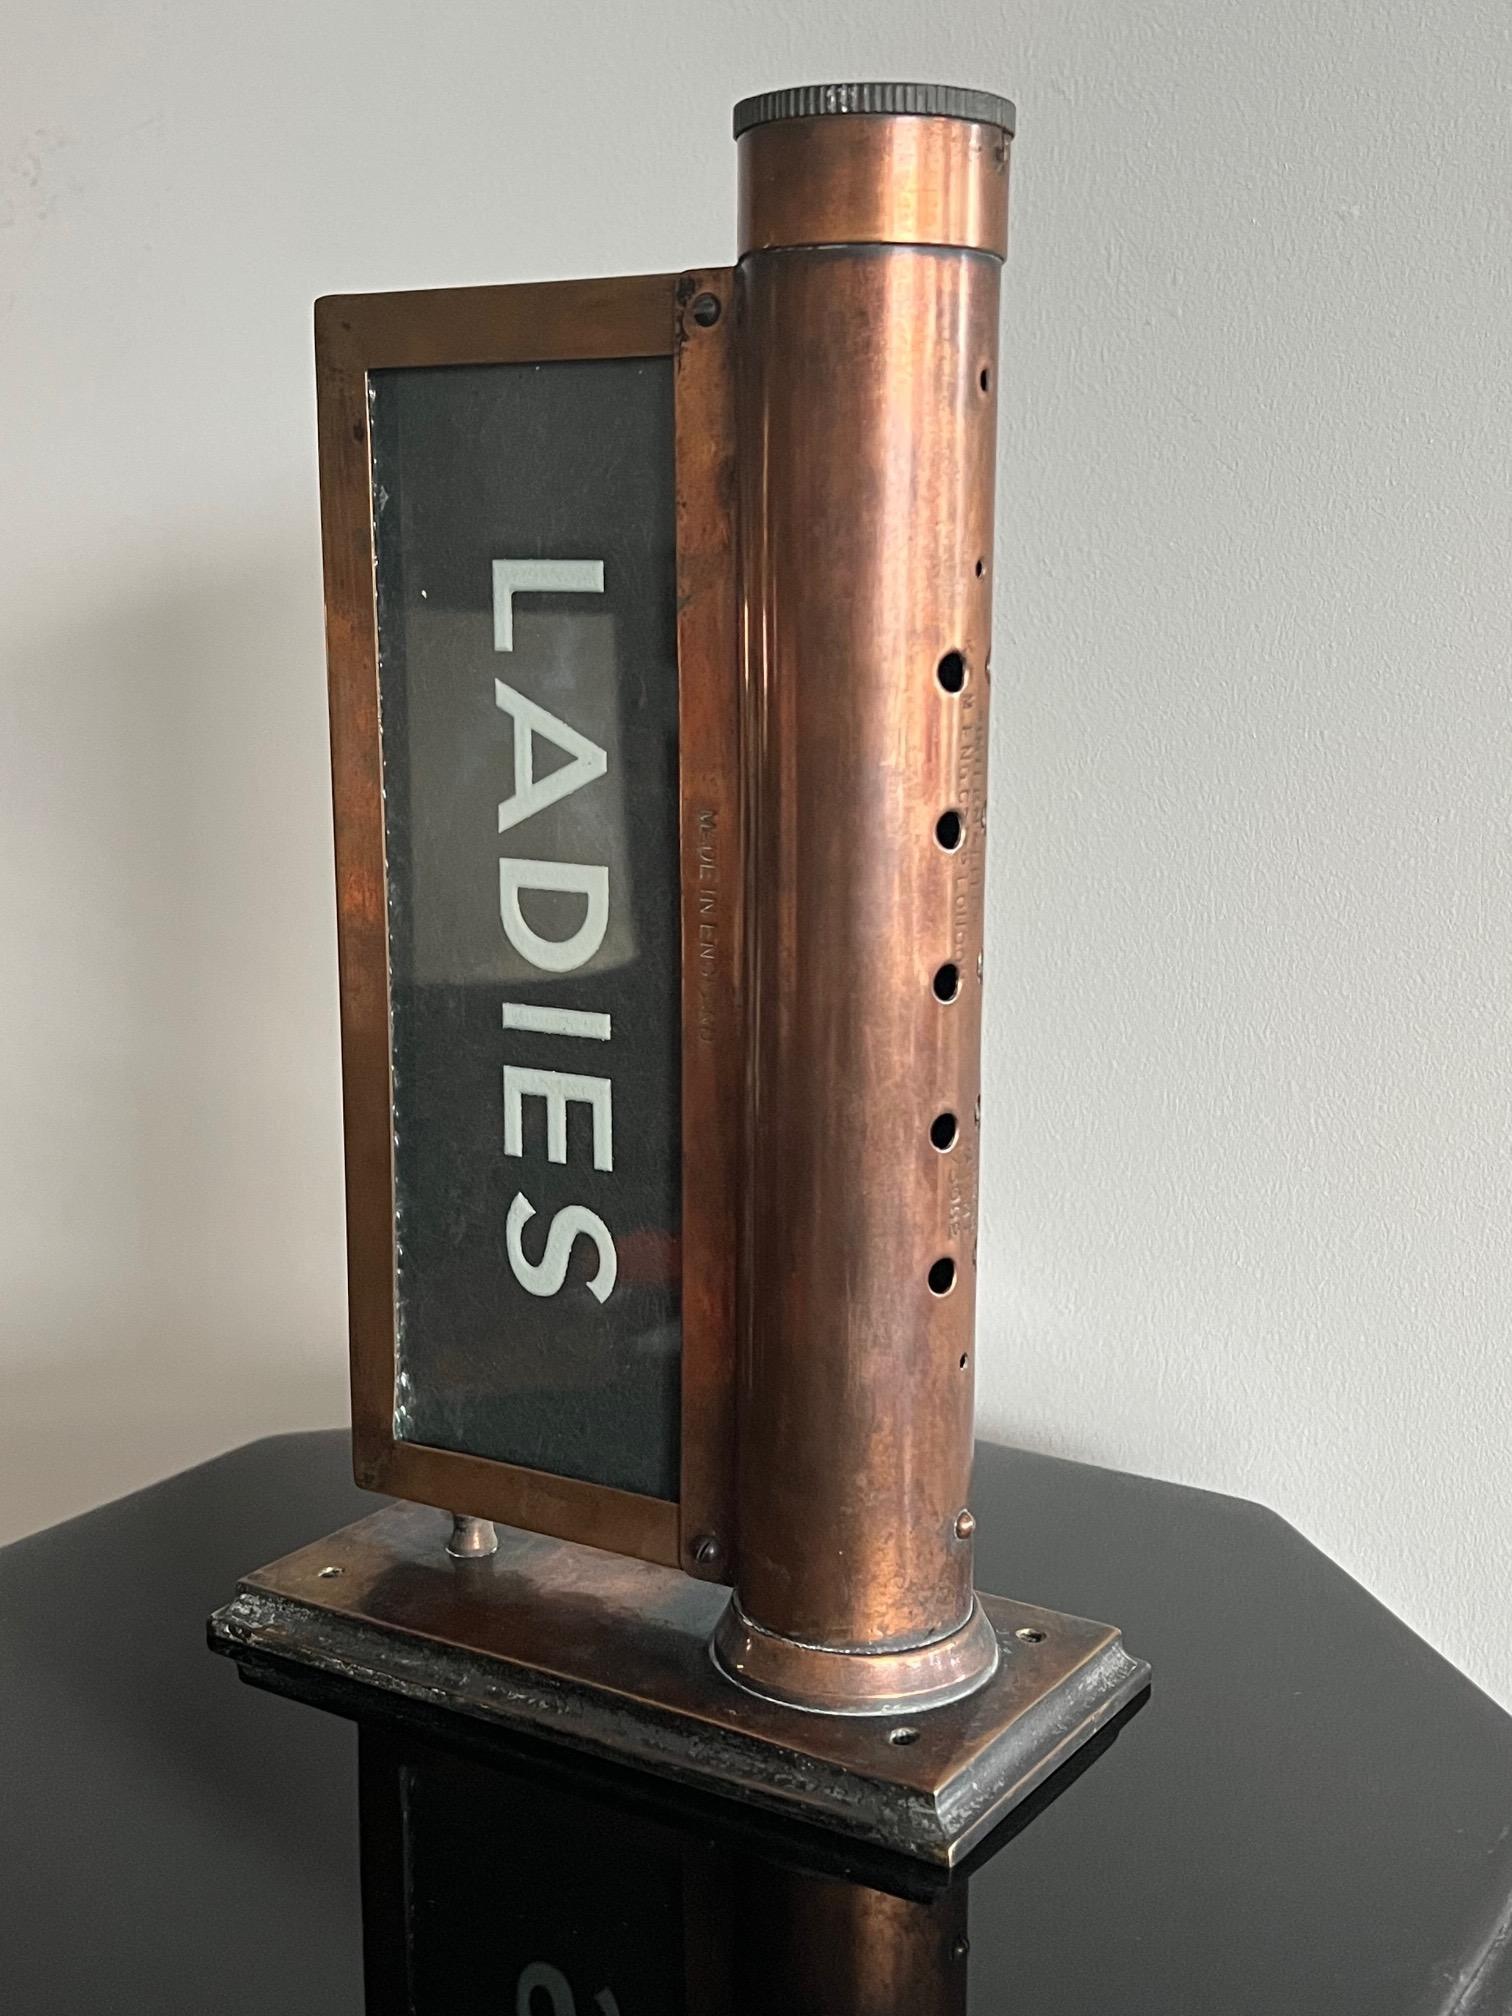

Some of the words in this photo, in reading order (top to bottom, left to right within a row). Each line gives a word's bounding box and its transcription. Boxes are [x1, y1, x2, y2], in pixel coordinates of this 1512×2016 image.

[492, 559, 618, 1304] LADIES
[698, 890, 717, 915] IN
[698, 924, 718, 1044] ENGND
